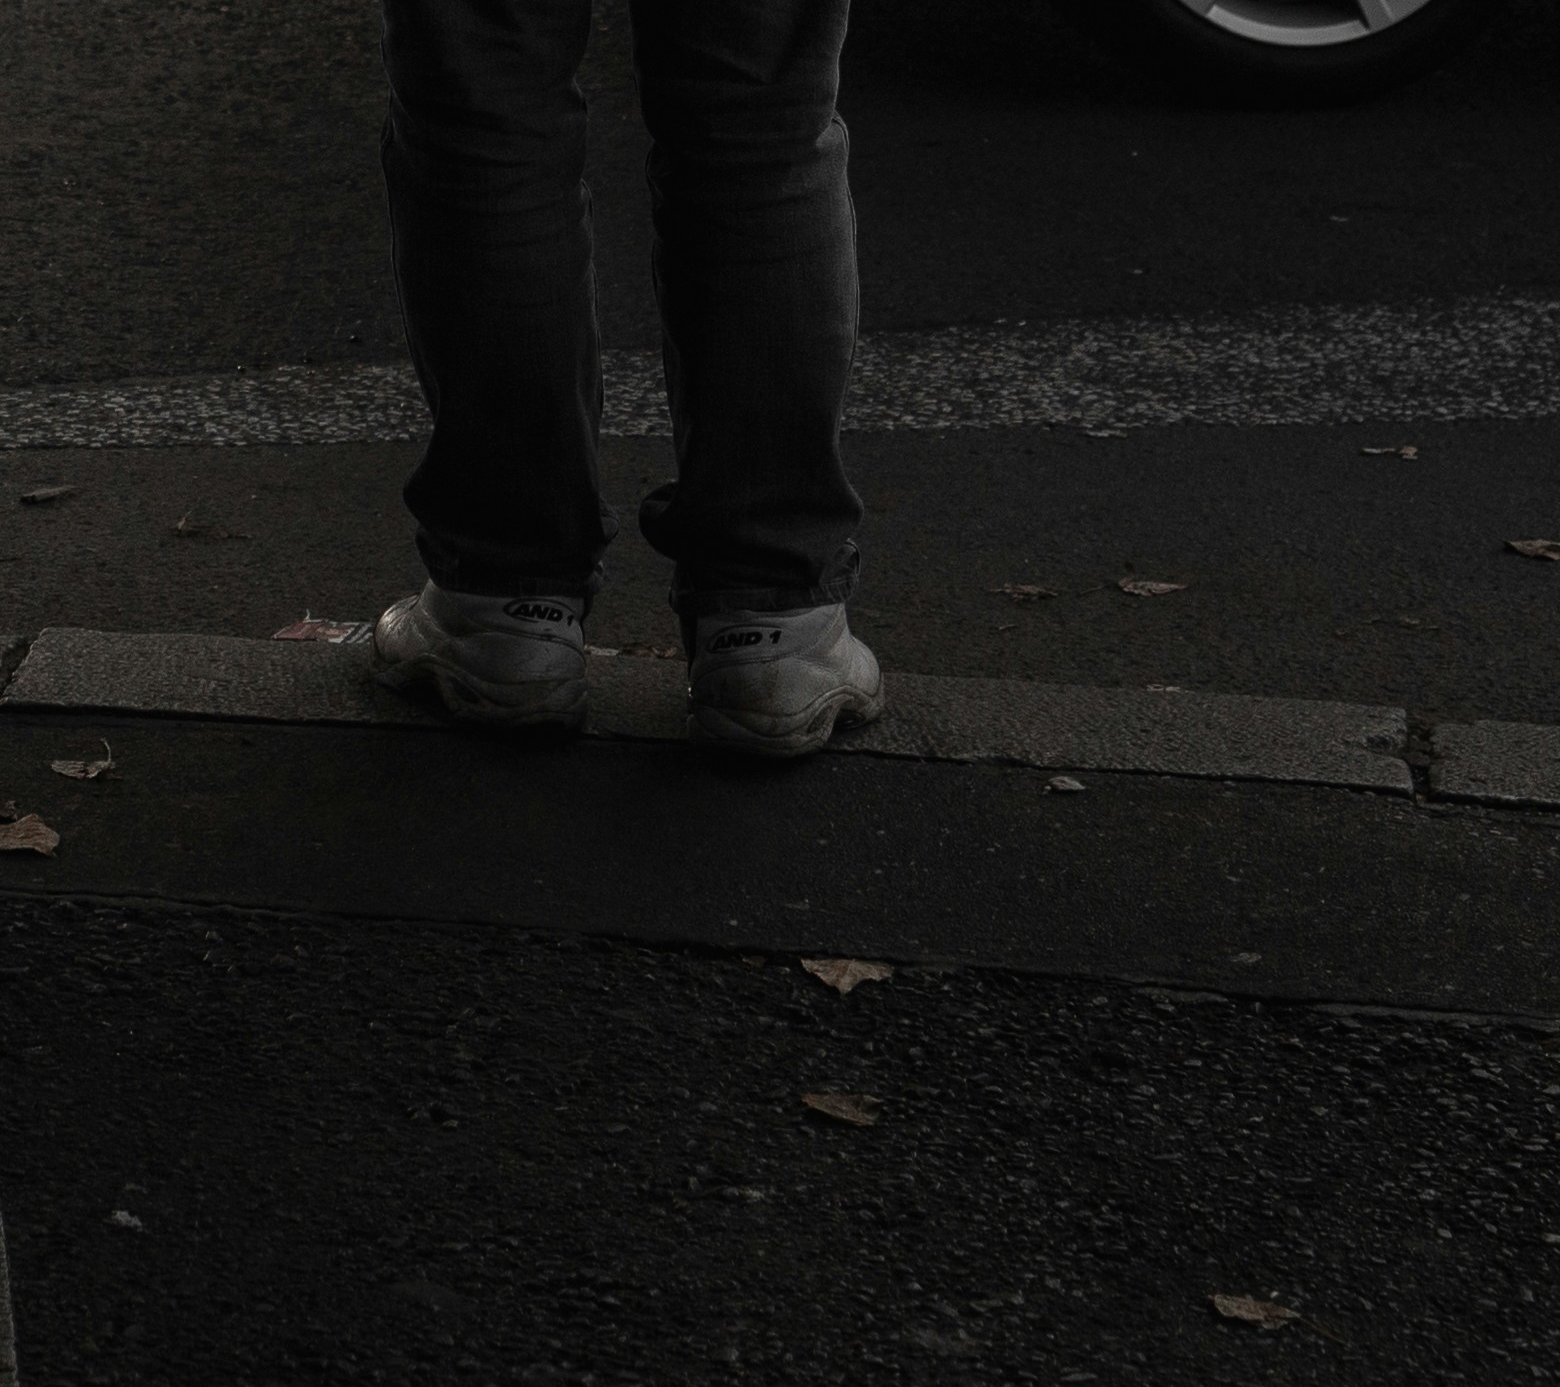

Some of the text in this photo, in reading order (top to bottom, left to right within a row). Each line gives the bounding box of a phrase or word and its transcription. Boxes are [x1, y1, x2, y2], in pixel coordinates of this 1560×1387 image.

[513, 604, 575, 627] AND 1
[712, 630, 782, 649] AND 1
